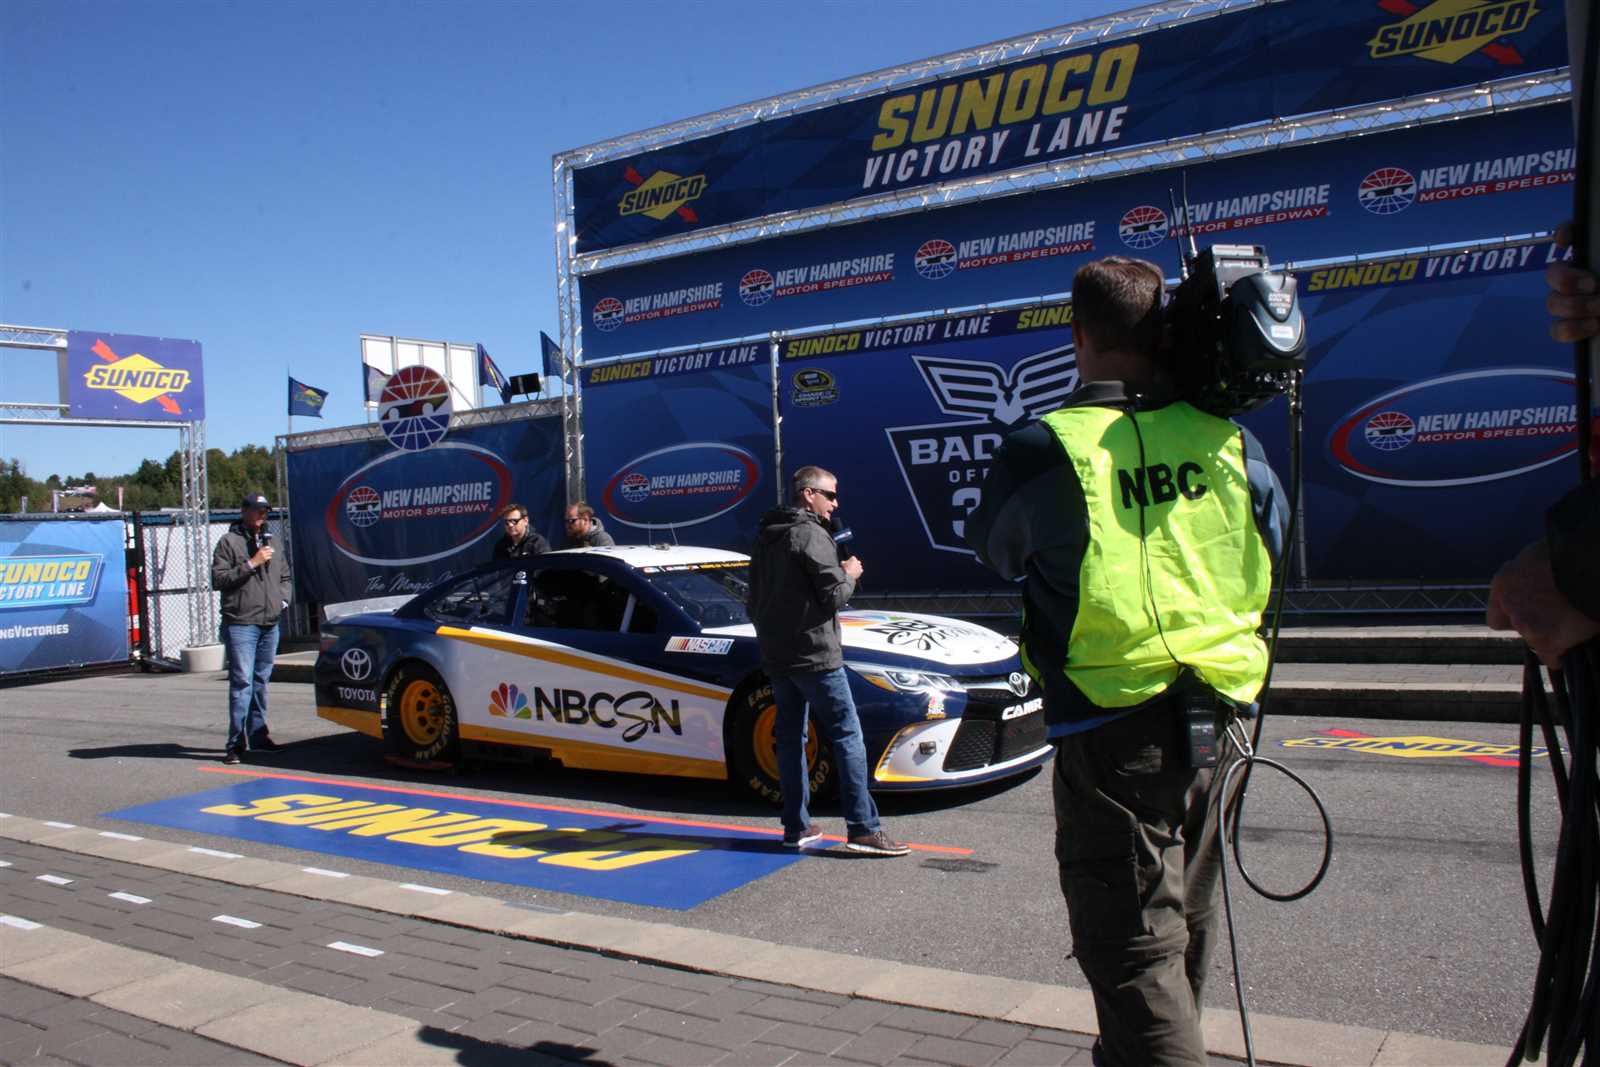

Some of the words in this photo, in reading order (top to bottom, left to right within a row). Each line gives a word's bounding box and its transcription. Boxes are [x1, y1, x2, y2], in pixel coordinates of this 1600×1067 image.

[1377, 3, 1530, 54] SUNOCO
[872, 43, 1140, 150] SUNOCO
[862, 129, 1010, 189] VICTORY
[1024, 105, 1129, 157] LANE
[1419, 164, 1471, 190] NEW
[1473, 148, 1577, 182] HAMPSHI
[622, 176, 703, 213] SUNOCO
[1419, 185, 1487, 202] MOTOR
[1495, 173, 1576, 192] SPEEDW
[1170, 202, 1213, 226] NEW
[1215, 184, 1330, 219] HAMPSHIRE
[1233, 208, 1325, 228] SPEEDWAY
[959, 239, 997, 258] NEW
[999, 221, 1095, 252] HAMPSHIRE
[776, 268, 808, 286] NEW
[810, 253, 895, 281] HAMPSHIRE
[960, 255, 1007, 269] MOTOR
[1013, 242, 1091, 262] SPEEDWAY
[1308, 258, 1417, 292] SUNOCO
[1425, 246, 1543, 278] VICTORY
[625, 299, 651, 314] NEW
[653, 283, 723, 309] HAMPSHIRE
[776, 284, 818, 297] MOTOR
[823, 273, 891, 289] SPEEDWAY
[625, 312, 661, 323] MOTOR
[664, 301, 720, 317] SPEEDWAY
[1016, 306, 1074, 330] SUNO
[786, 333, 861, 357] SUNOCO
[864, 322, 936, 348] VICTORY
[943, 316, 992, 339] LANE
[90, 367, 185, 390] SUNOCO
[590, 361, 651, 383] SUNOCO
[654, 352, 713, 375] VICTORY
[719, 346, 758, 366] LANE
[1418, 414, 1461, 432] NEW
[1464, 405, 1577, 429] HAMPSHIRE
[1417, 430, 1476, 442] MOTOR
[1483, 424, 1577, 439] SPEEDWAY
[652, 476, 676, 489] NEW
[676, 470, 741, 486] HAMPSHIRE
[652, 488, 684, 496] MOTOR
[687, 485, 737, 494] SPEEDWAY
[1117, 462, 1207, 509] NBC
[383, 489, 412, 508] NEW
[413, 482, 492, 505] HAMPSHIRE
[383, 508, 423, 519] MOTOR
[427, 503, 488, 517] SPEEDWAY
[0, 584, 44, 600] CTORY
[48, 582, 86, 597] LANE
[338, 687, 377, 702] TOYOTA
[535, 686, 682, 742] NBCSN
[1002, 698, 1043, 720] CAMR
[1296, 737, 1551, 755] SUNOCO
[199, 794, 713, 870] SUNOCO
